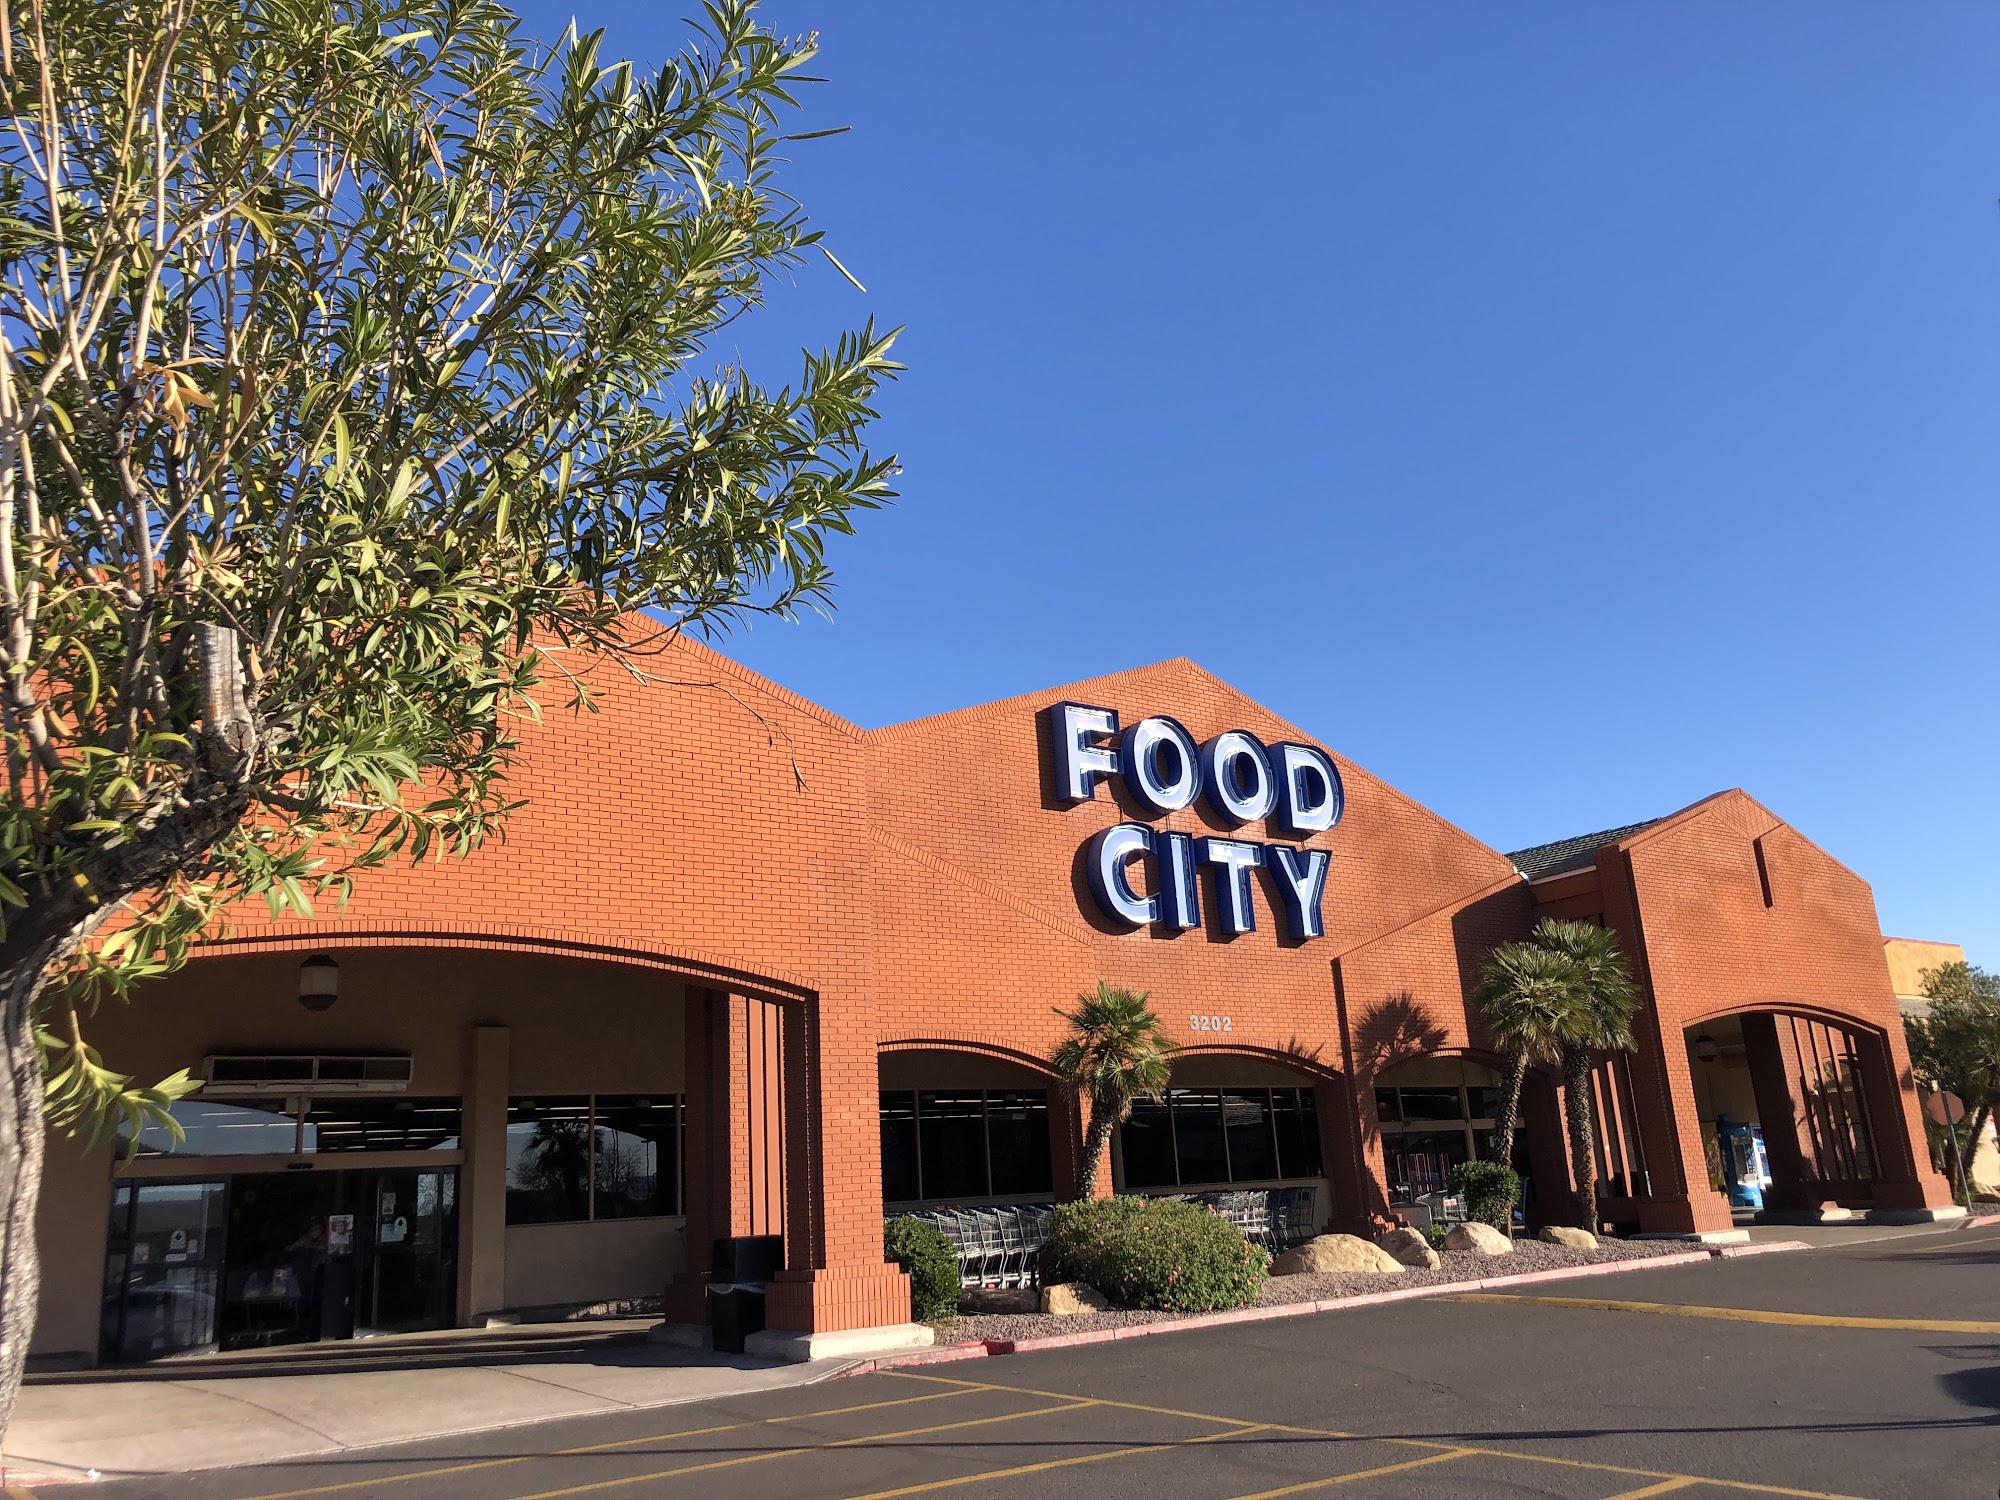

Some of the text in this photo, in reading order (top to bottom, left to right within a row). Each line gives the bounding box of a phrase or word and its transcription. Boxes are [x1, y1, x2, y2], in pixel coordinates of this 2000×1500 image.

[1051, 701, 1344, 832] FOOD
[1088, 822, 1331, 937] CITY
[1190, 1014, 1233, 1032] 3202
